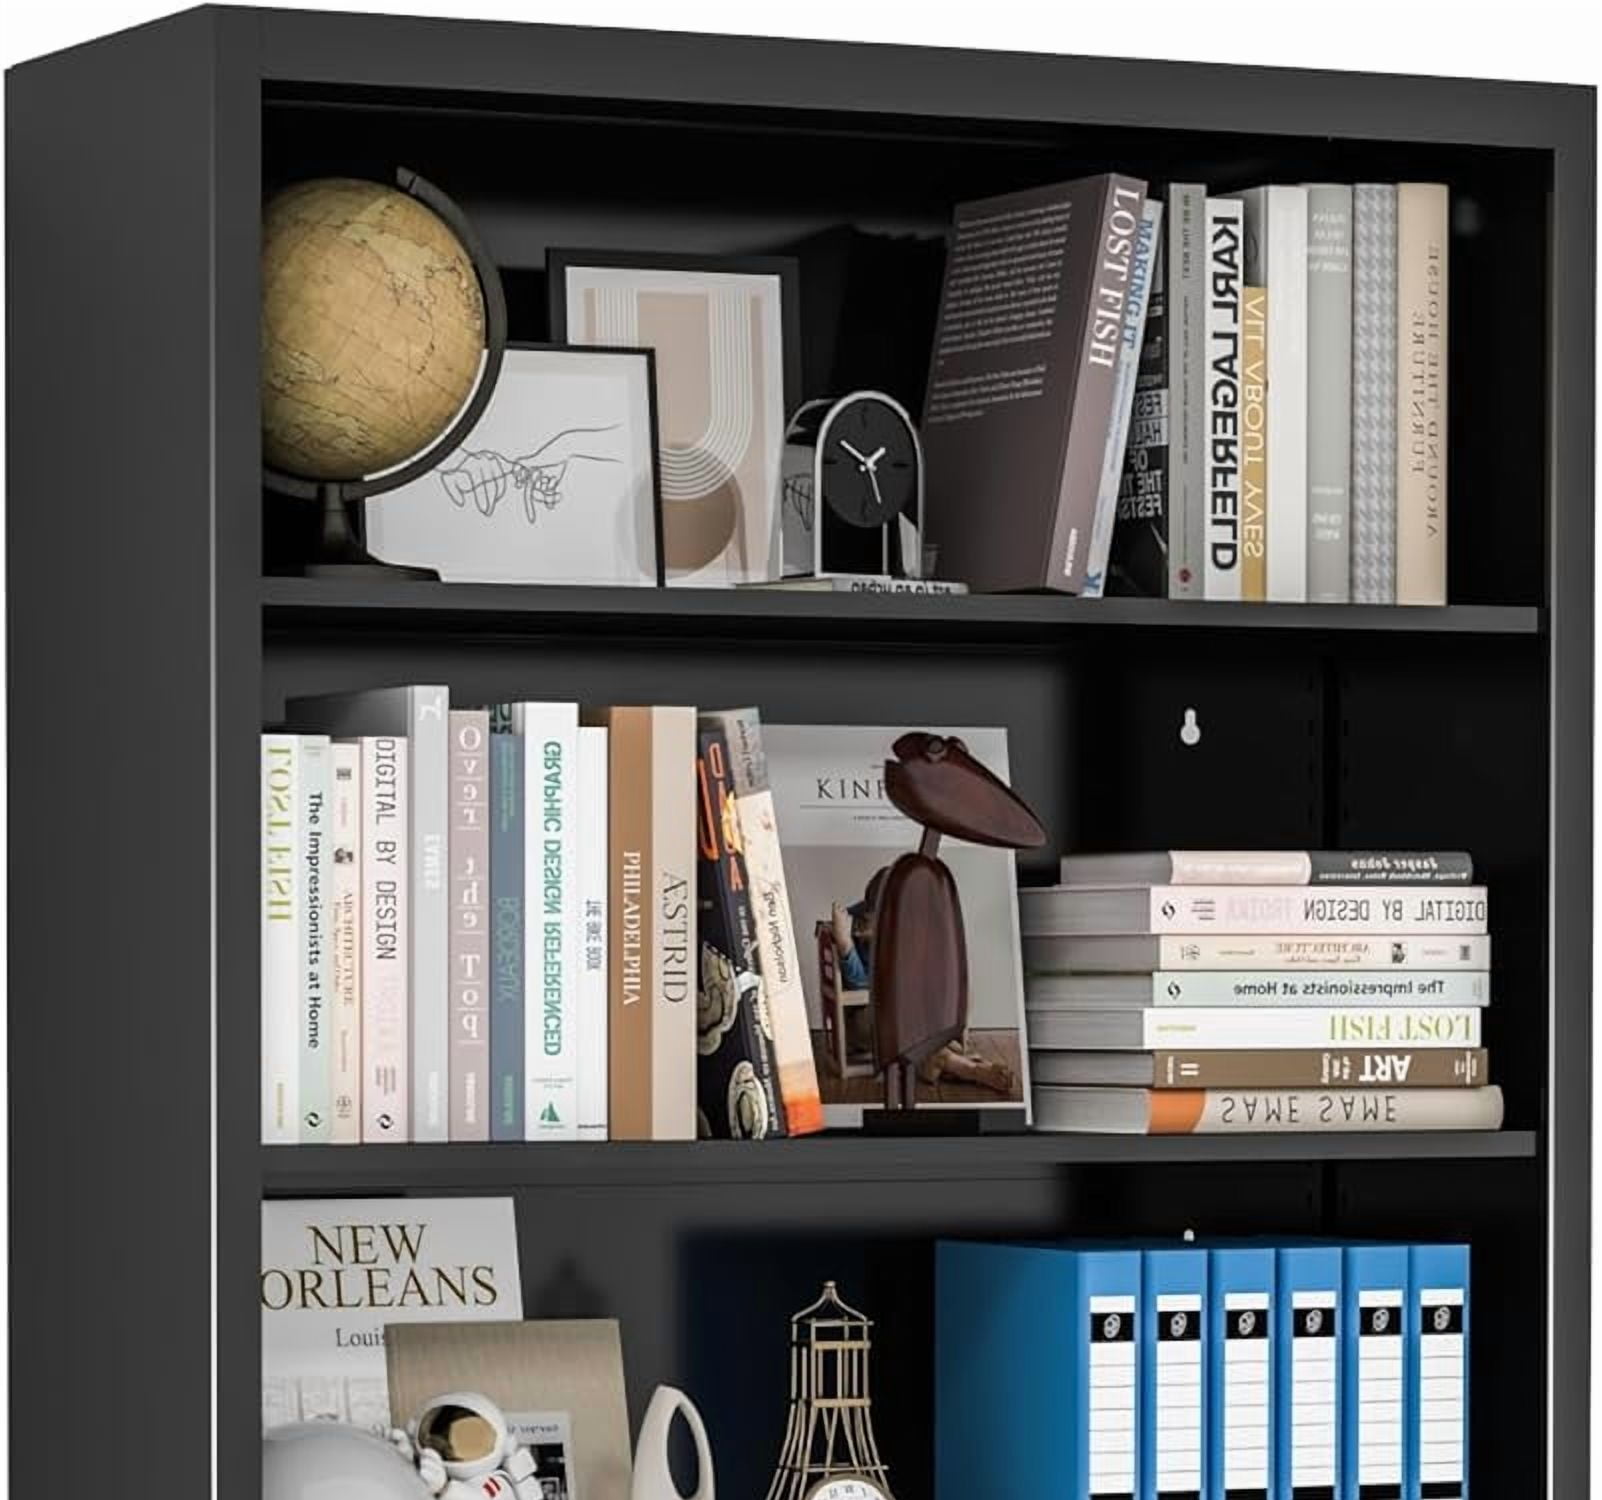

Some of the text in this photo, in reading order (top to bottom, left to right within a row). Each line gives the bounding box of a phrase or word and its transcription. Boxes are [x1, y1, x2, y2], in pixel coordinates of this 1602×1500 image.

[1104, 186, 1140, 281] LOST
[1123, 217, 1154, 318] MAKING
[1088, 287, 1124, 368] FISH
[375, 738, 397, 960] DIGITAL BY DESIGN
[305, 792, 323, 1050] The Impressionists at Home
[622, 851, 642, 1006] PHILADELPHIA
[1329, 1013, 1472, 1041] LOST FISH
[1358, 1053, 1411, 1081] ART
[260, 1265, 498, 1310] ORLEANS
[306, 1223, 428, 1265] NEW
